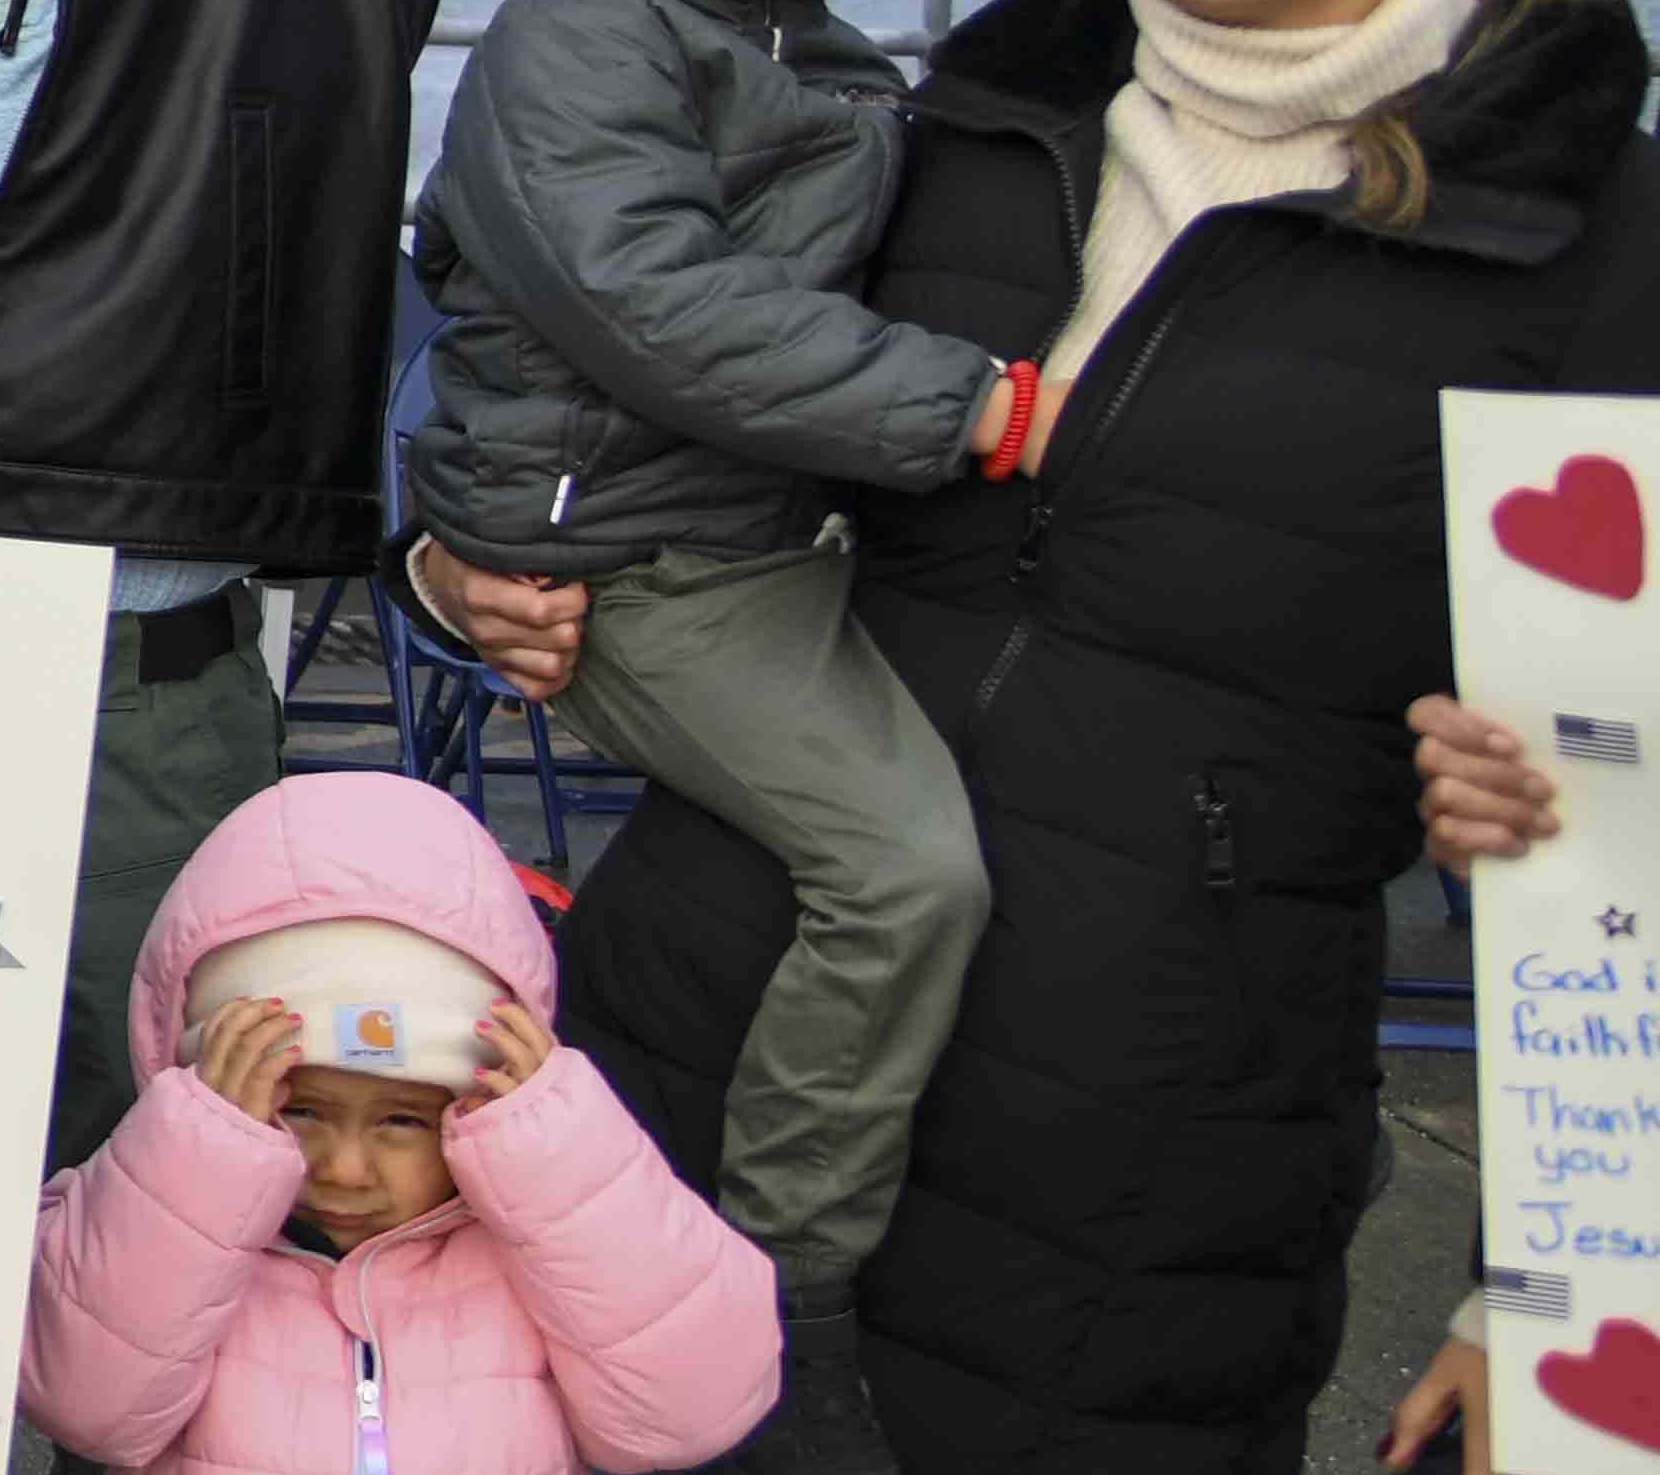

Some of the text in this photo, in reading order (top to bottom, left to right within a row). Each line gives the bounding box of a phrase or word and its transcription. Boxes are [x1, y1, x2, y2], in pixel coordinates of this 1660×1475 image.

[1512, 953, 1618, 993] God
[1510, 999, 1660, 1057] faithf
[1534, 1144, 1633, 1185] you
